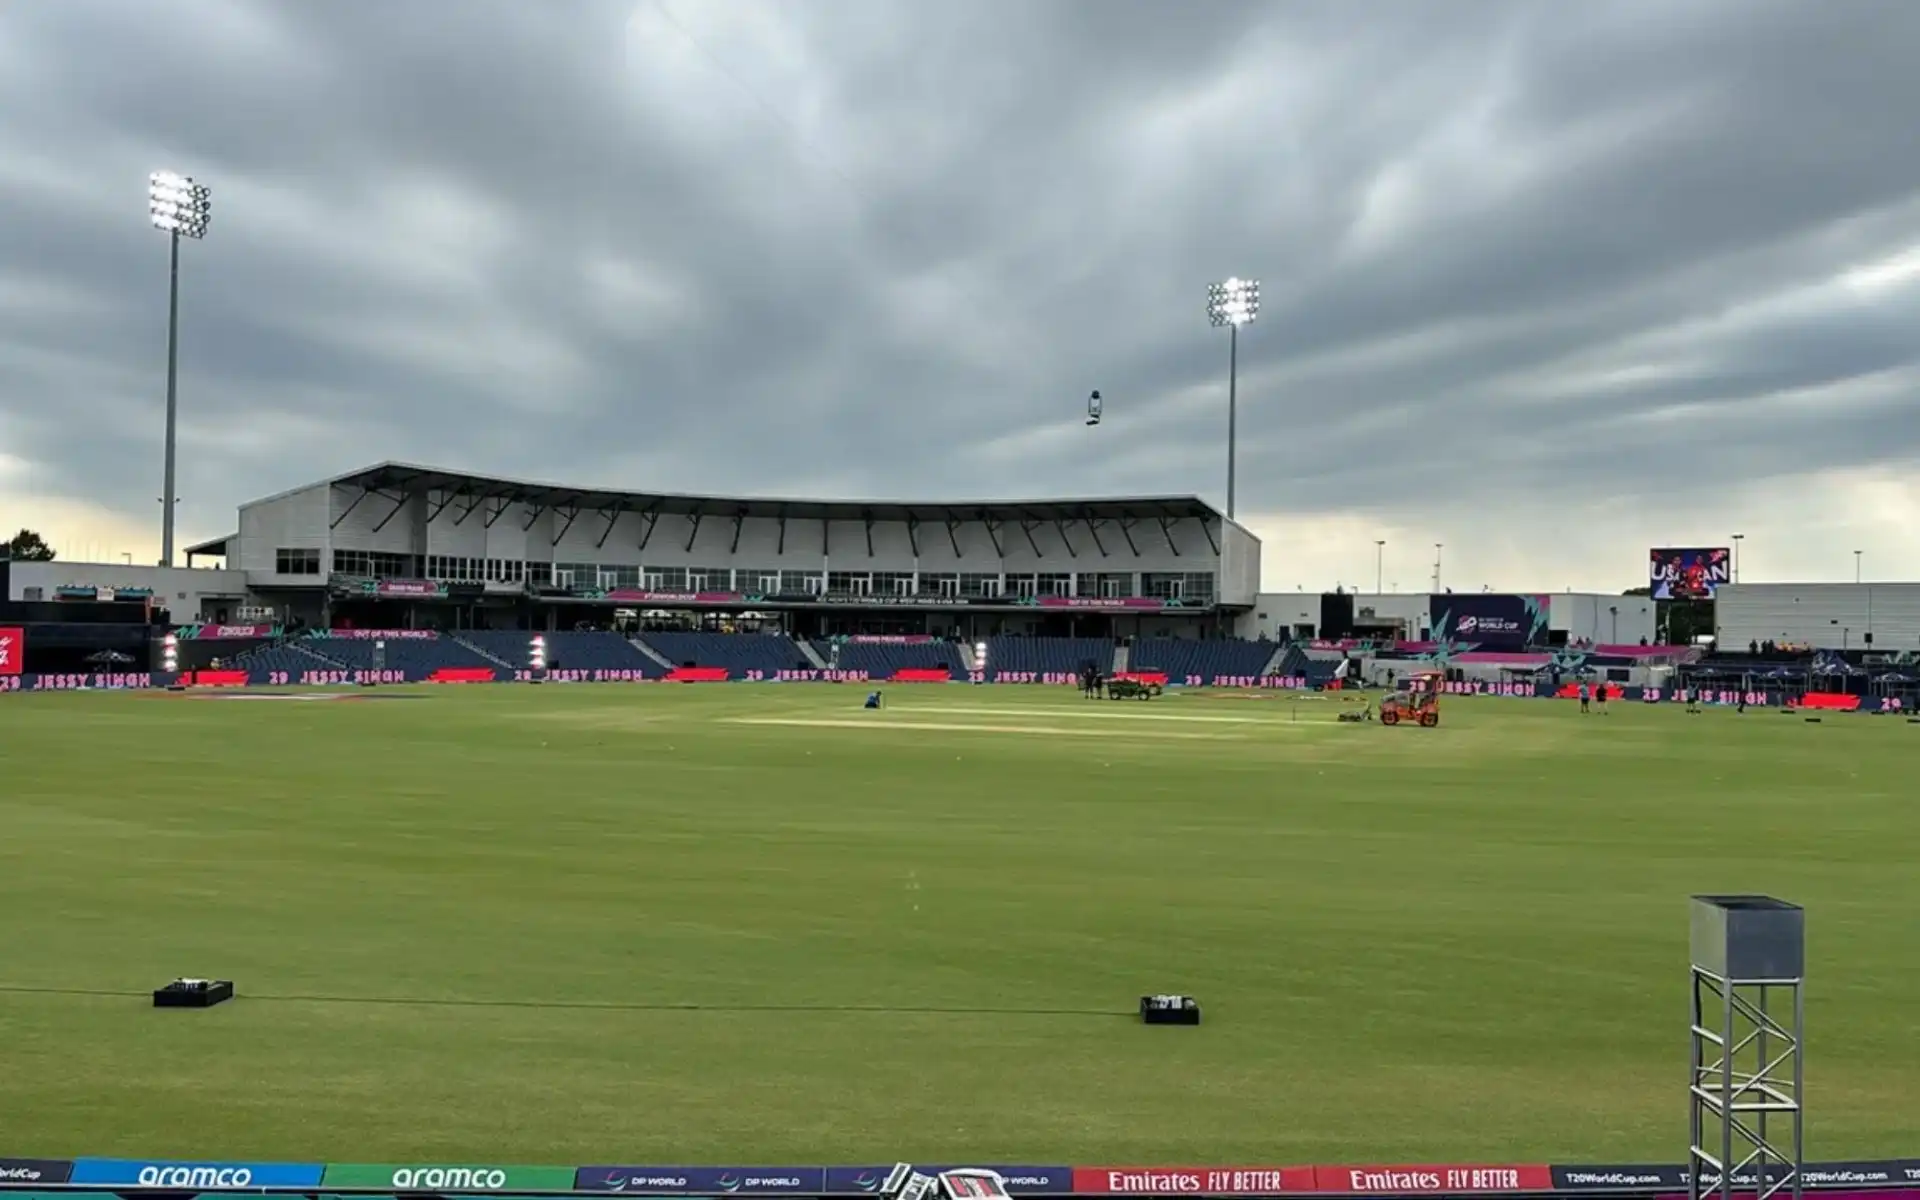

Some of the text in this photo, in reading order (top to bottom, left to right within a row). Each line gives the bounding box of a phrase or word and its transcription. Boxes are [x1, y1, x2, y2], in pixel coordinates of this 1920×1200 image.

[33, 674, 89, 689] JESSY
[95, 673, 151, 688] SINGH
[269, 670, 404, 684] 29 JESSY SINGH
[543, 670, 589, 681] JESSY
[595, 670, 643, 680] SINGH
[774, 670, 818, 681] JESSY
[823, 670, 869, 681] SINGH
[994, 672, 1037, 684] JESSY
[1042, 672, 1082, 684] SING
[1212, 675, 1255, 688] JESSY
[1260, 676, 1306, 688] SINGH
[1488, 683, 1535, 696] SINGH
[1643, 689, 1660, 701] 29
[1881, 697, 1901, 712] 29
[0, 1167, 41, 1180] orldCup
[138, 1166, 251, 1187] aramco
[392, 1168, 506, 1189] aramco
[1350, 1169, 1519, 1190] Emirates FLY BETTER
[1565, 1172, 1661, 1185] T20WorldCup.com
[631, 1177, 687, 1187] DP WORLD
[745, 1177, 800, 1187] DP WORLD
[1011, 1176, 1049, 1185] WORLD
[1108, 1171, 1281, 1191] Emirates FLY BETTER
